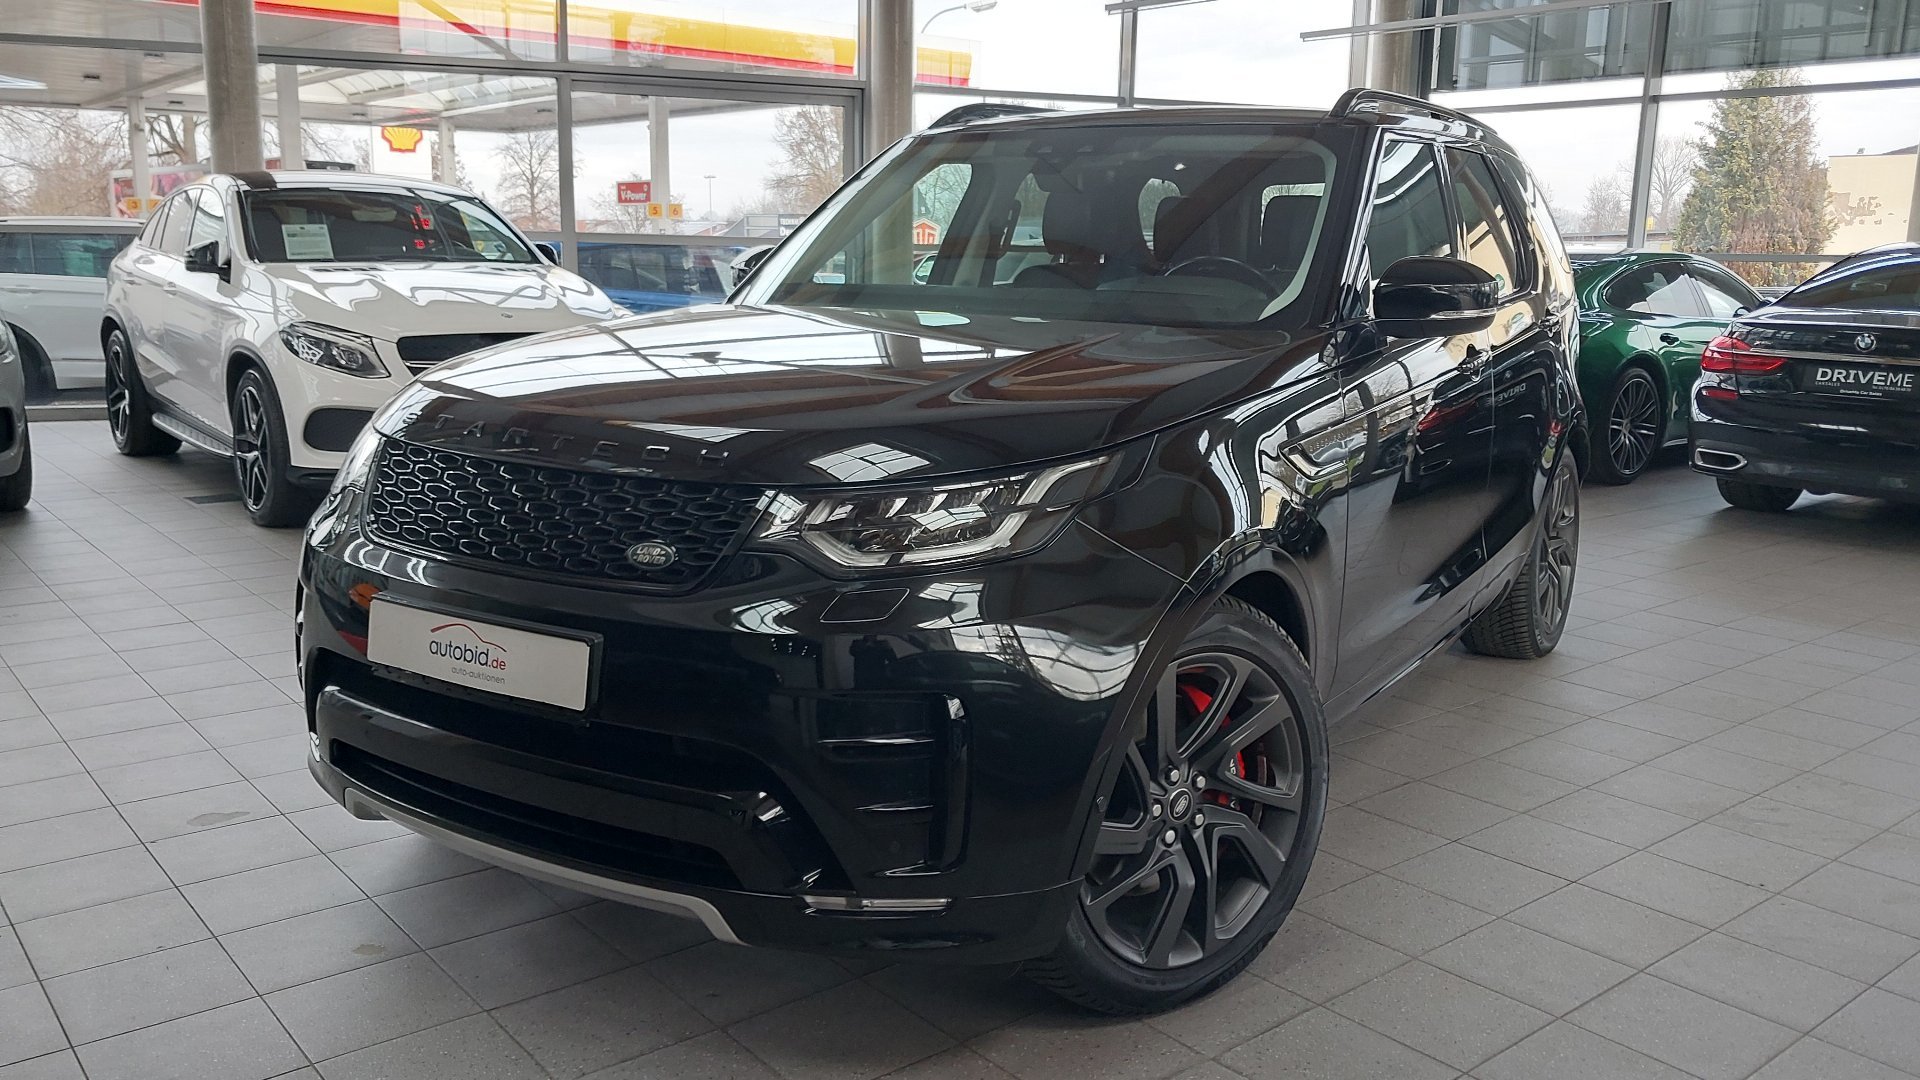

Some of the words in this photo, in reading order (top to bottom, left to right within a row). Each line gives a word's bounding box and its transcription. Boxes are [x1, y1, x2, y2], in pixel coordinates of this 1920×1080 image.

[620, 190, 647, 201] V-Power
[652, 206, 659, 215] 5
[672, 207, 679, 216] 6
[1816, 367, 1915, 388] DRIVEME
[402, 410, 730, 468] STARTECH
[636, 546, 661, 556] LAND
[636, 554, 666, 565] ROVER
[429, 640, 507, 671] autobid.de
[451, 666, 506, 685] auto-auktionen
